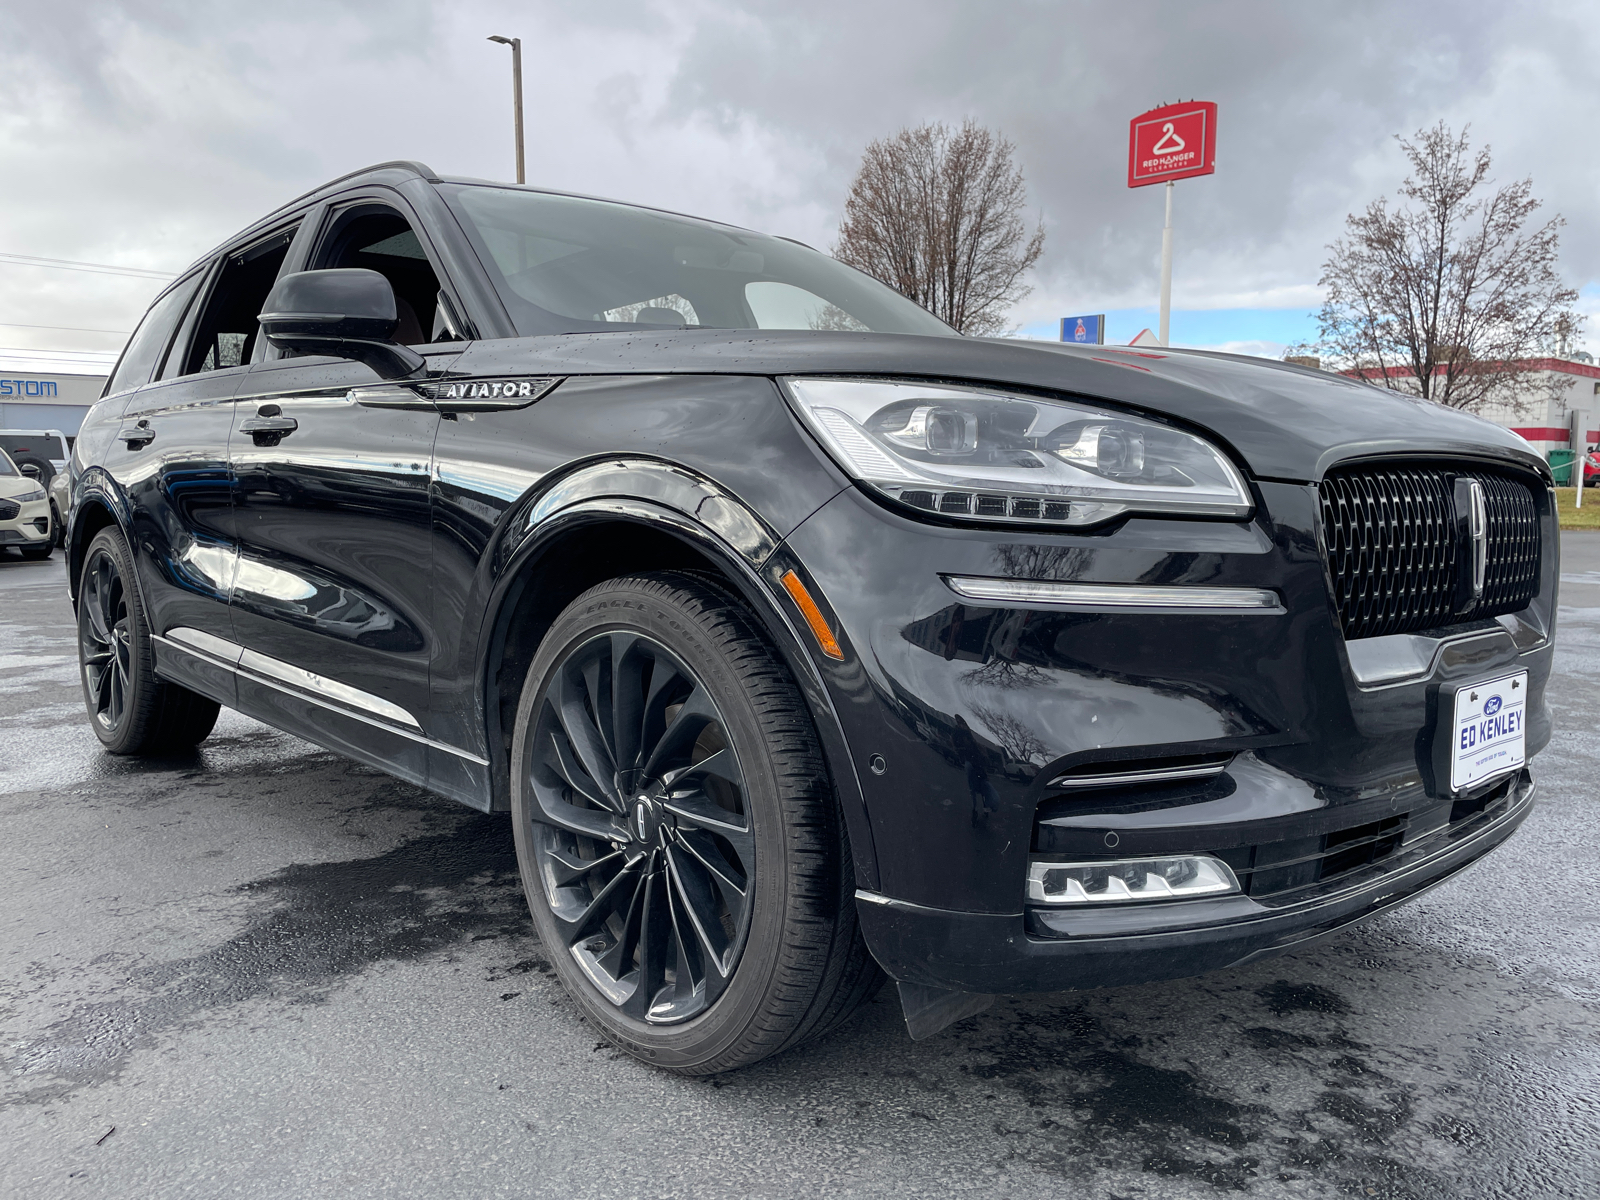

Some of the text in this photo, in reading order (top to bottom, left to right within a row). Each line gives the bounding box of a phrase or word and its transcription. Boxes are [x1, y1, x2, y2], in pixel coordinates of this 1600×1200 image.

[1142, 152, 1195, 168] RED HANGER
[1149, 161, 1187, 172] CLEANERS
[0, 380, 57, 396] STOM
[446, 382, 532, 397] AVIATOR
[586, 599, 649, 614] EAGLE
[1460, 709, 1522, 750] ED KENLEY
